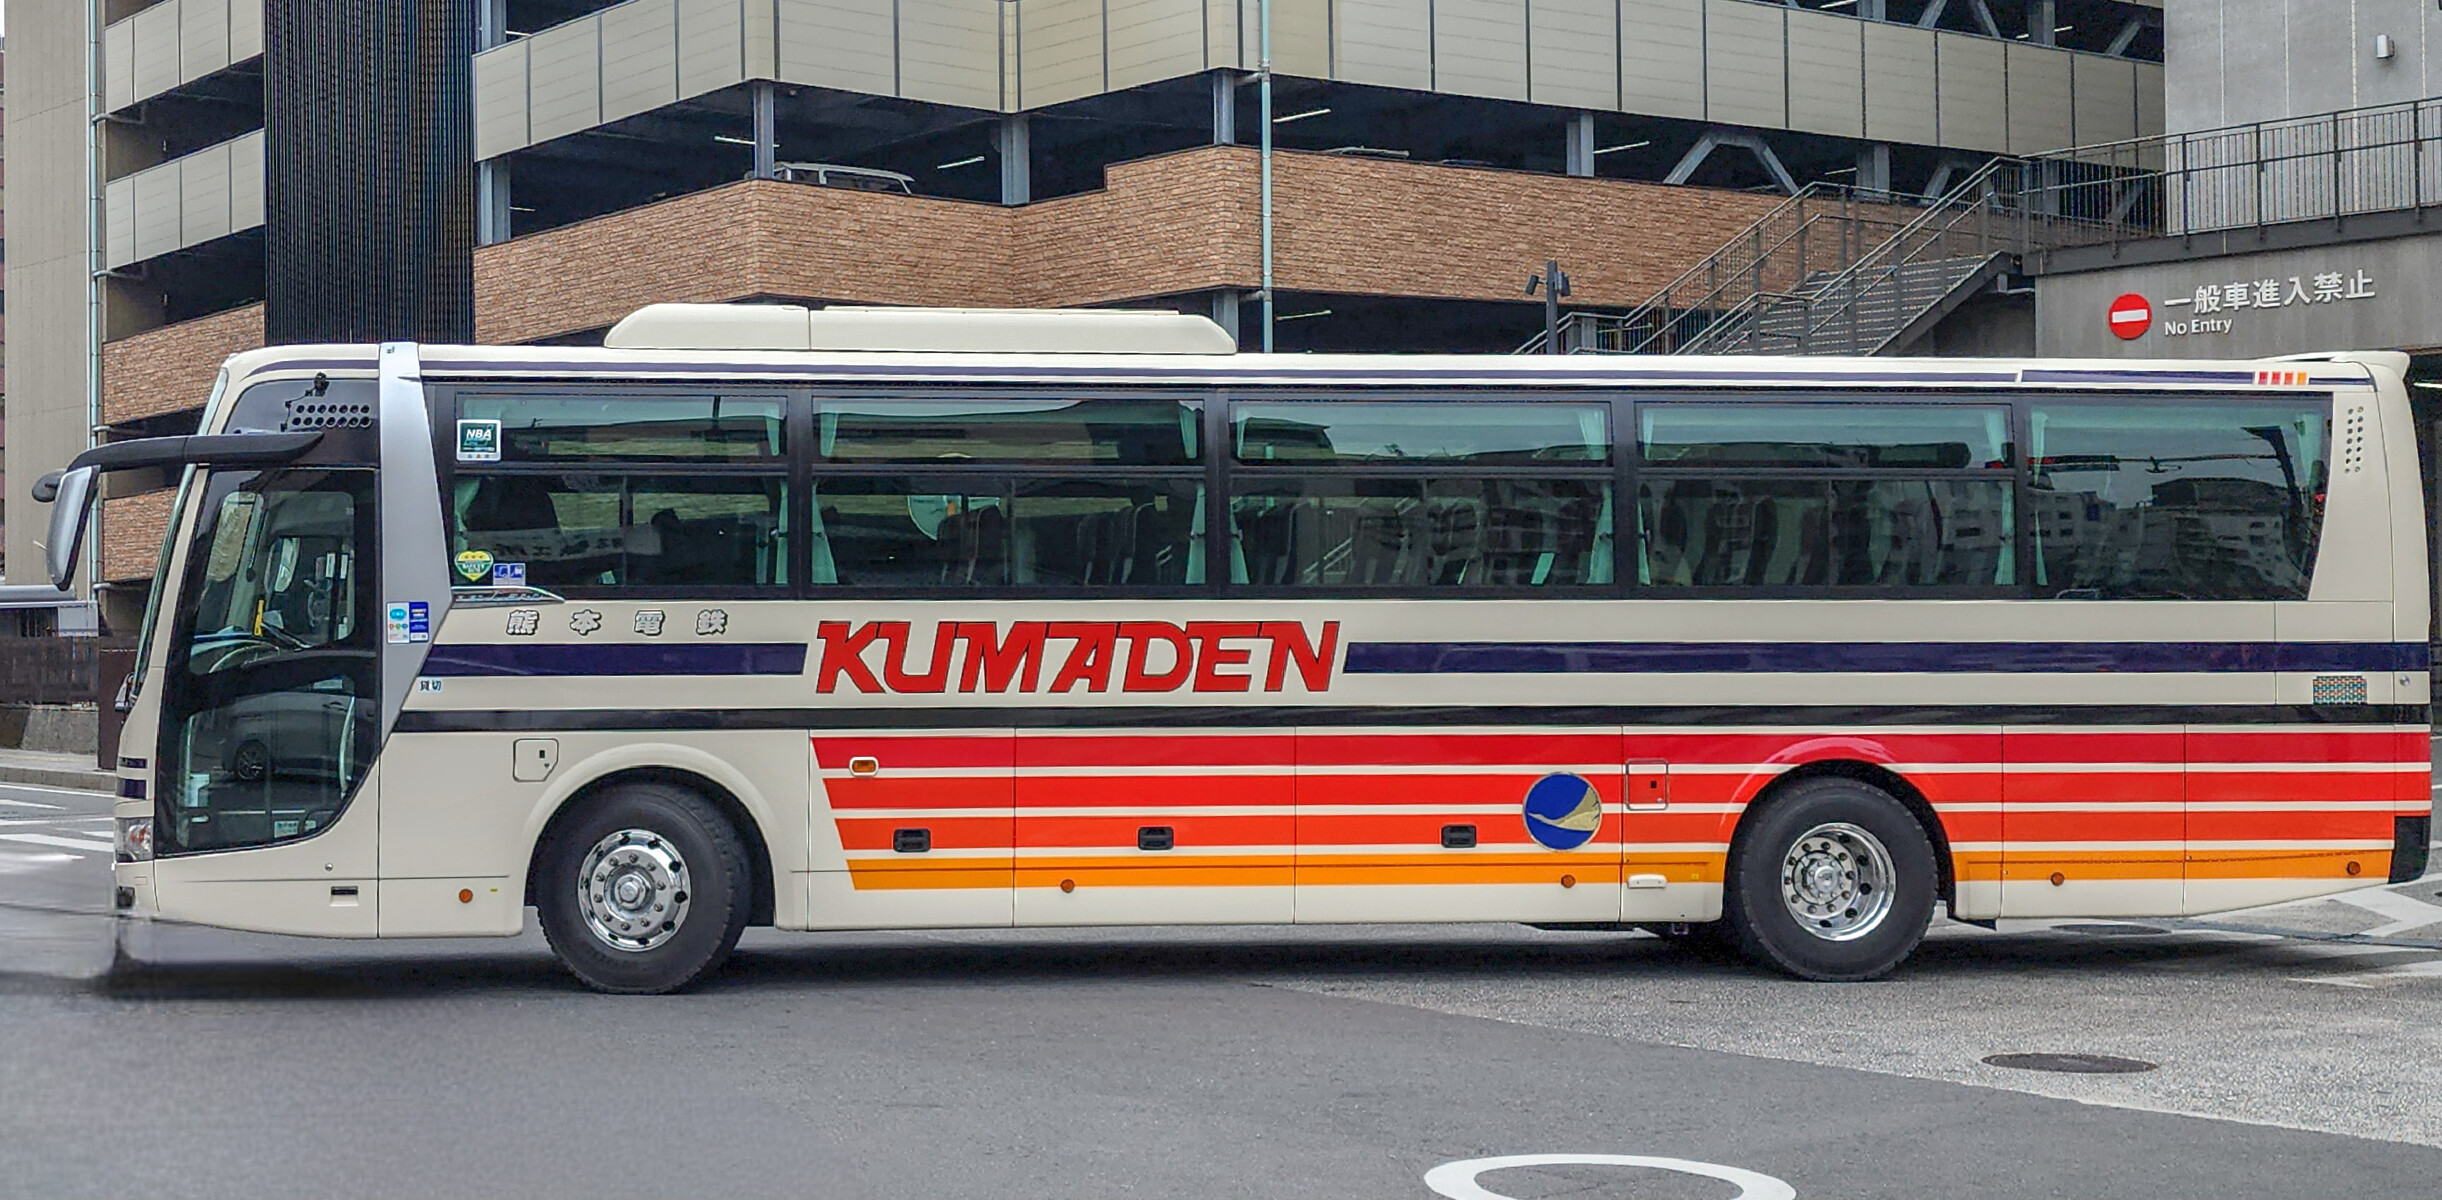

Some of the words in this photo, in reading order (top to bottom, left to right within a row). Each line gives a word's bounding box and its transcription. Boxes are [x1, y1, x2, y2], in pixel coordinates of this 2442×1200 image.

[2164, 269, 2376, 314] 一般車進入禁止
[2164, 320, 2187, 336] No
[2191, 318, 2233, 334] Entry
[466, 428, 492, 441] NBA
[506, 608, 728, 636] 熊本電鉄
[815, 620, 1341, 694] KUMADEN
